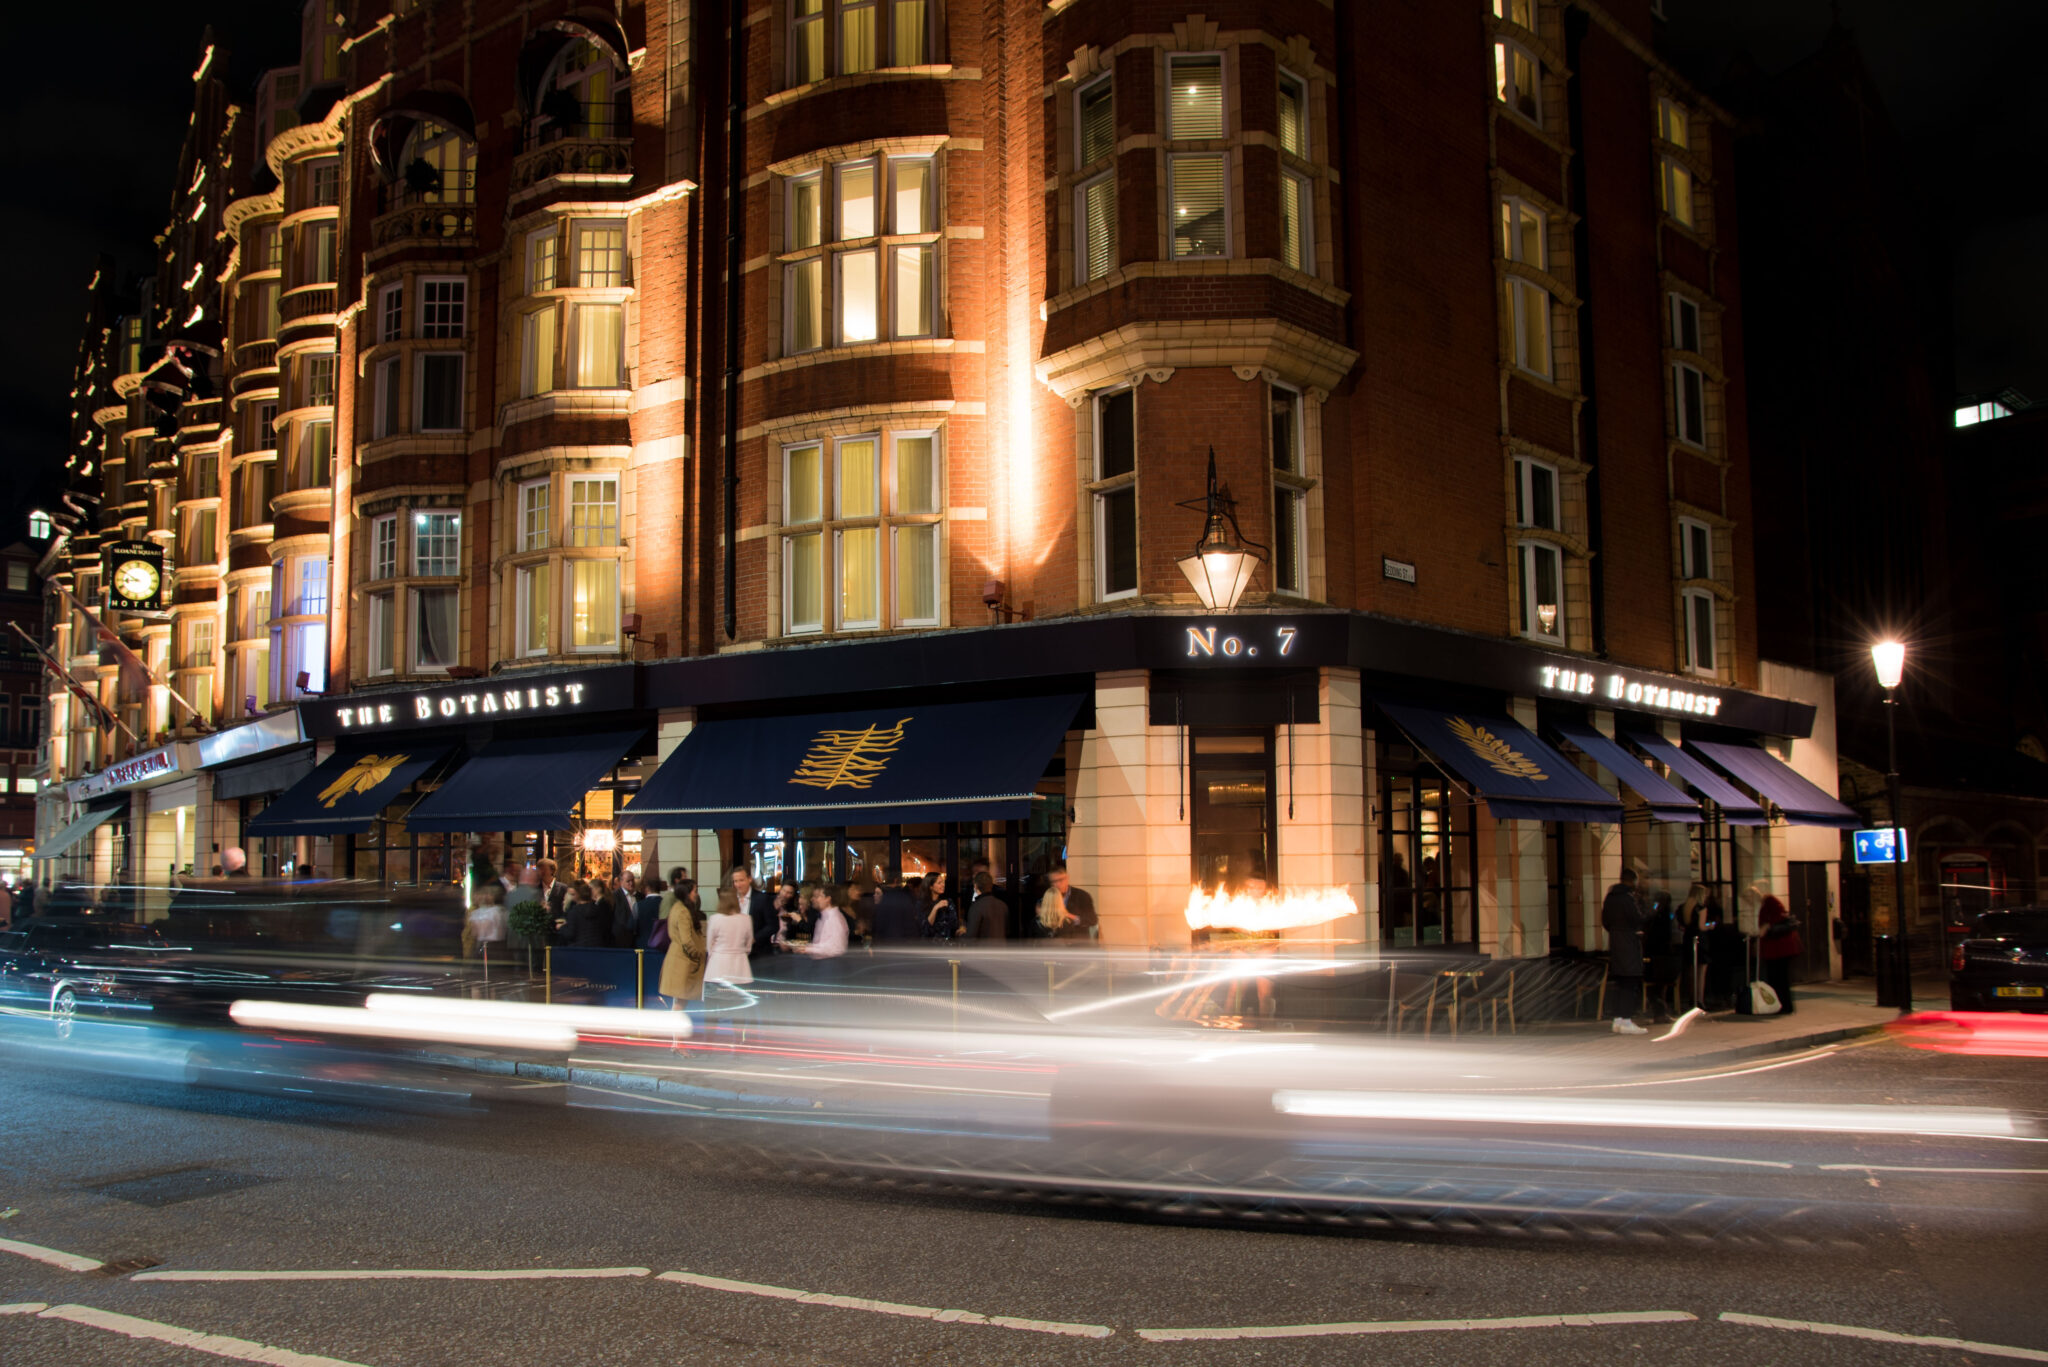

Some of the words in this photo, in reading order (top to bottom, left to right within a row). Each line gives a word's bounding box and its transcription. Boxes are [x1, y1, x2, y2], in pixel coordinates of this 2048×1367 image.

[111, 600, 159, 608] HOTEL
[1185, 626, 1259, 657] No.
[1277, 626, 1298, 656] 7
[336, 704, 393, 728] THE
[415, 683, 584, 720] BOTANIST
[1541, 665, 1595, 695] THE
[1607, 674, 1721, 717] BOTANIST
